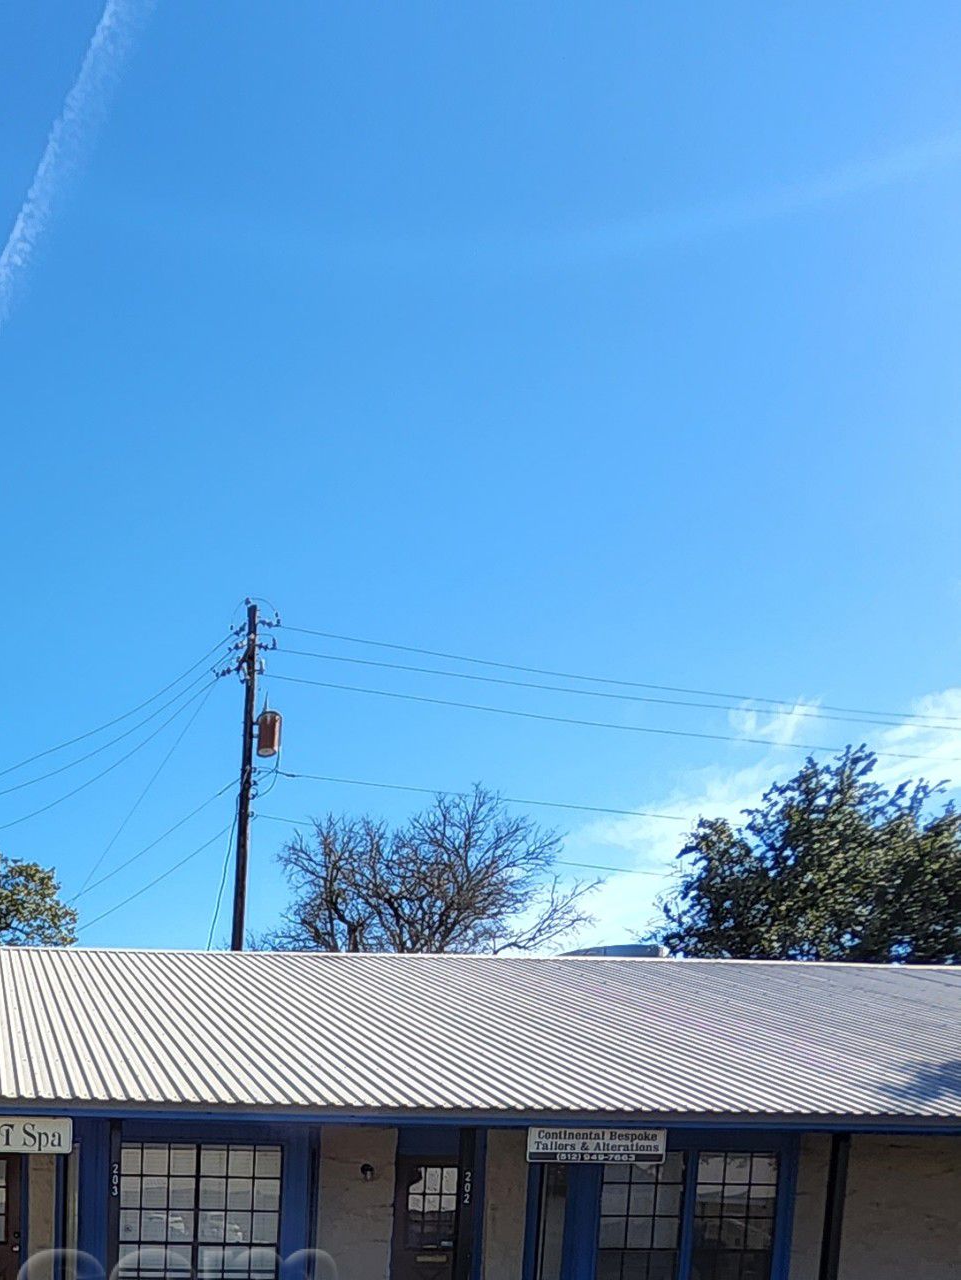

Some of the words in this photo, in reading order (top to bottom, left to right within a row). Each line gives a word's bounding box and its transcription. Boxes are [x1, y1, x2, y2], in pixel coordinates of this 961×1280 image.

[22, 1122, 62, 1151] Spa
[534, 1140, 576, 1151] Tailors
[580, 1141, 590, 1151] &
[594, 1142, 659, 1152] Alterations
[538, 1129, 605, 1141] Continental
[609, 1131, 658, 1143] Bespoke
[556, 1153, 581, 1161] (512)
[111, 1163, 119, 1196] 203
[463, 1171, 472, 1204] 202
